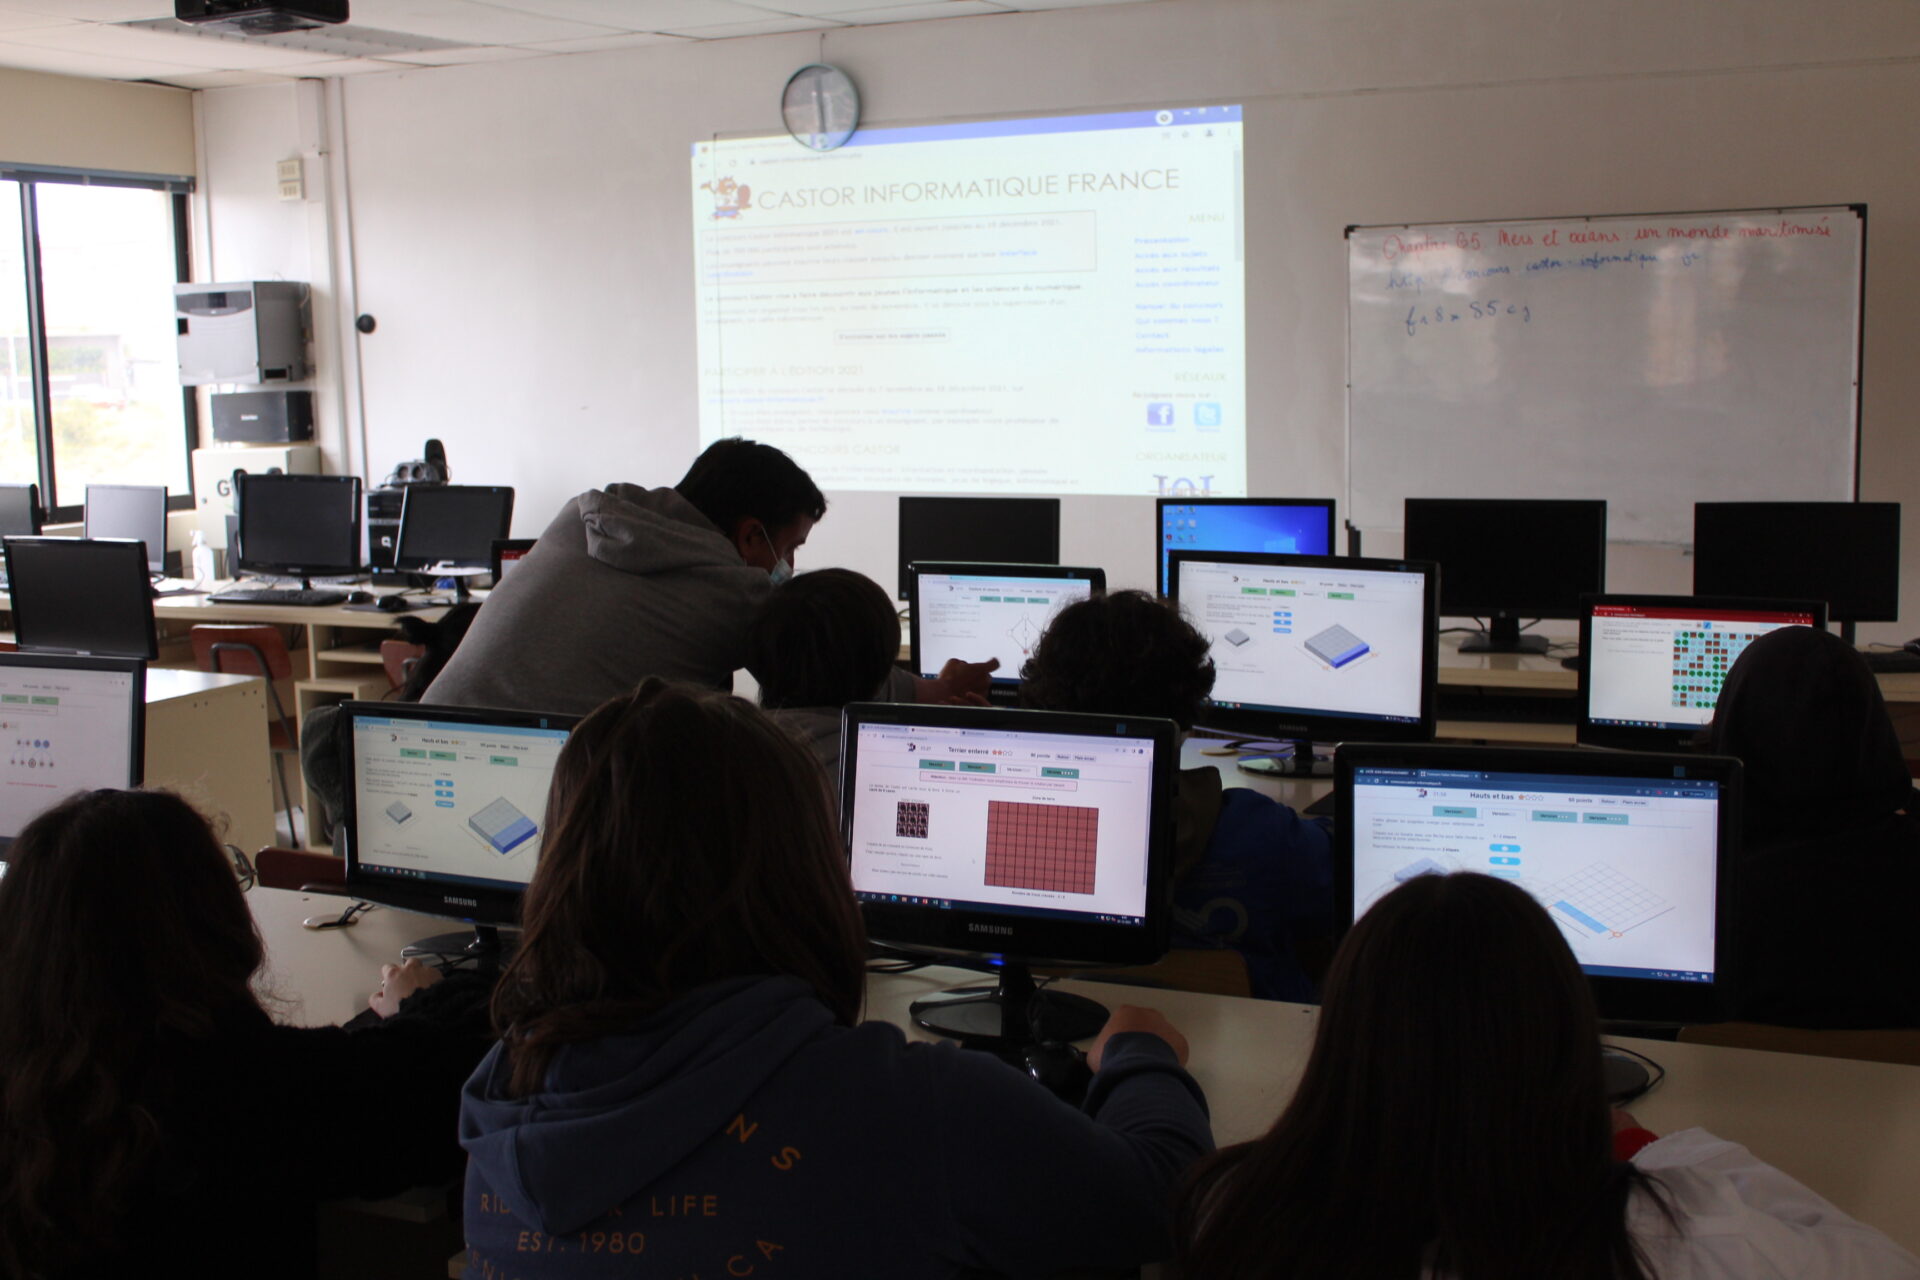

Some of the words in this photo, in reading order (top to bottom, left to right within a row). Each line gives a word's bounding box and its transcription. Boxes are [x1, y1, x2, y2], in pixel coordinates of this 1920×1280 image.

[758, 186, 857, 211] CASTOR
[864, 175, 1058, 205] INFORMATIQUE
[1067, 168, 1180, 194] FRANCE
[1187, 213, 1226, 225] MENU
[1542, 229, 1561, 247] et
[1667, 224, 1732, 241] monde
[1470, 791, 1491, 801] Hauts
[1492, 793, 1500, 801] et
[1501, 793, 1514, 802] bas
[443, 895, 478, 908] SAMSUNG
[968, 921, 1014, 938] SAMSUNG
[651, 1194, 718, 1217] LIFE
[516, 1231, 566, 1253] EST.
[579, 1231, 646, 1255] 1980
